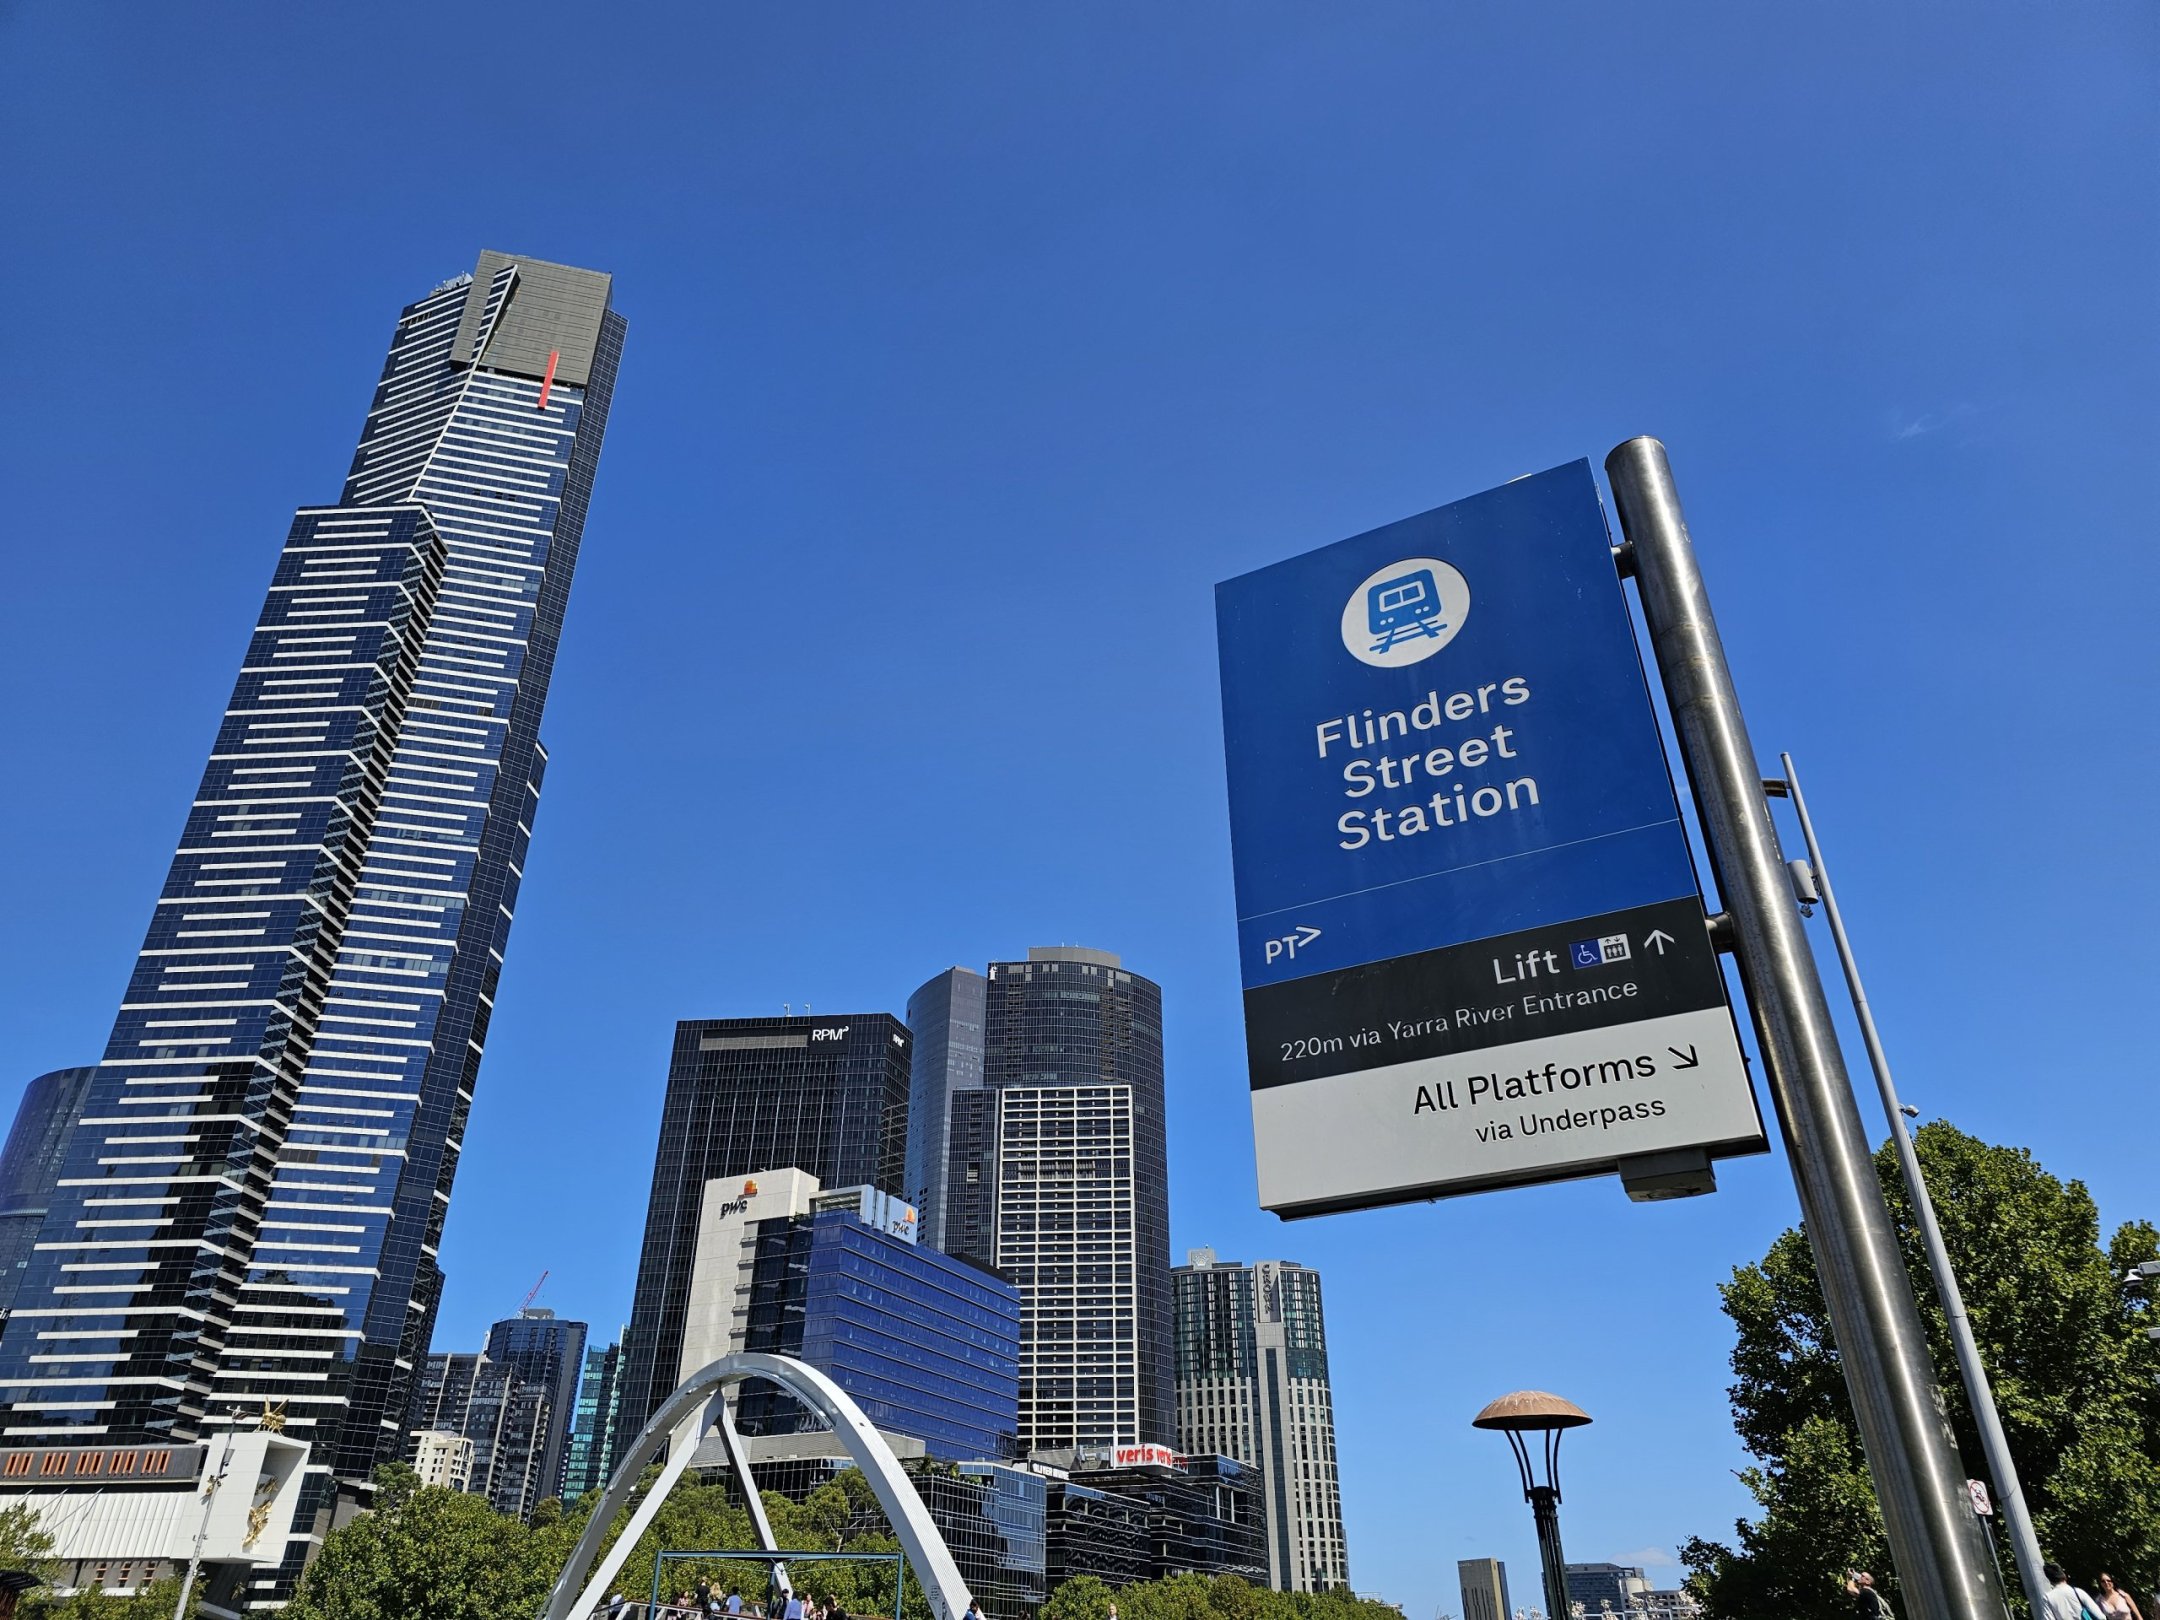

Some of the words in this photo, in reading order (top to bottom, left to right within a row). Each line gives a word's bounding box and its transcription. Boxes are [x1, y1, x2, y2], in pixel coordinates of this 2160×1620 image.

[1316, 676, 1531, 758] Flinders
[1343, 724, 1517, 798] Street
[1337, 777, 1540, 850] Station
[1493, 950, 1561, 985] Lift
[1280, 1037, 1343, 1062] 220m
[1349, 1027, 1382, 1049] via
[1387, 1018, 1449, 1040] Yarra
[1455, 1004, 1515, 1028] River
[1522, 980, 1638, 1016] Entrance
[1412, 1080, 1459, 1115] All
[1467, 1055, 1656, 1105] Platforms
[1474, 1123, 1513, 1143] via
[1518, 1100, 1667, 1137] Underpass
[720, 1200, 748, 1219] pwc
[892, 1220, 910, 1235] pwc
[1117, 1445, 1154, 1464] veris
